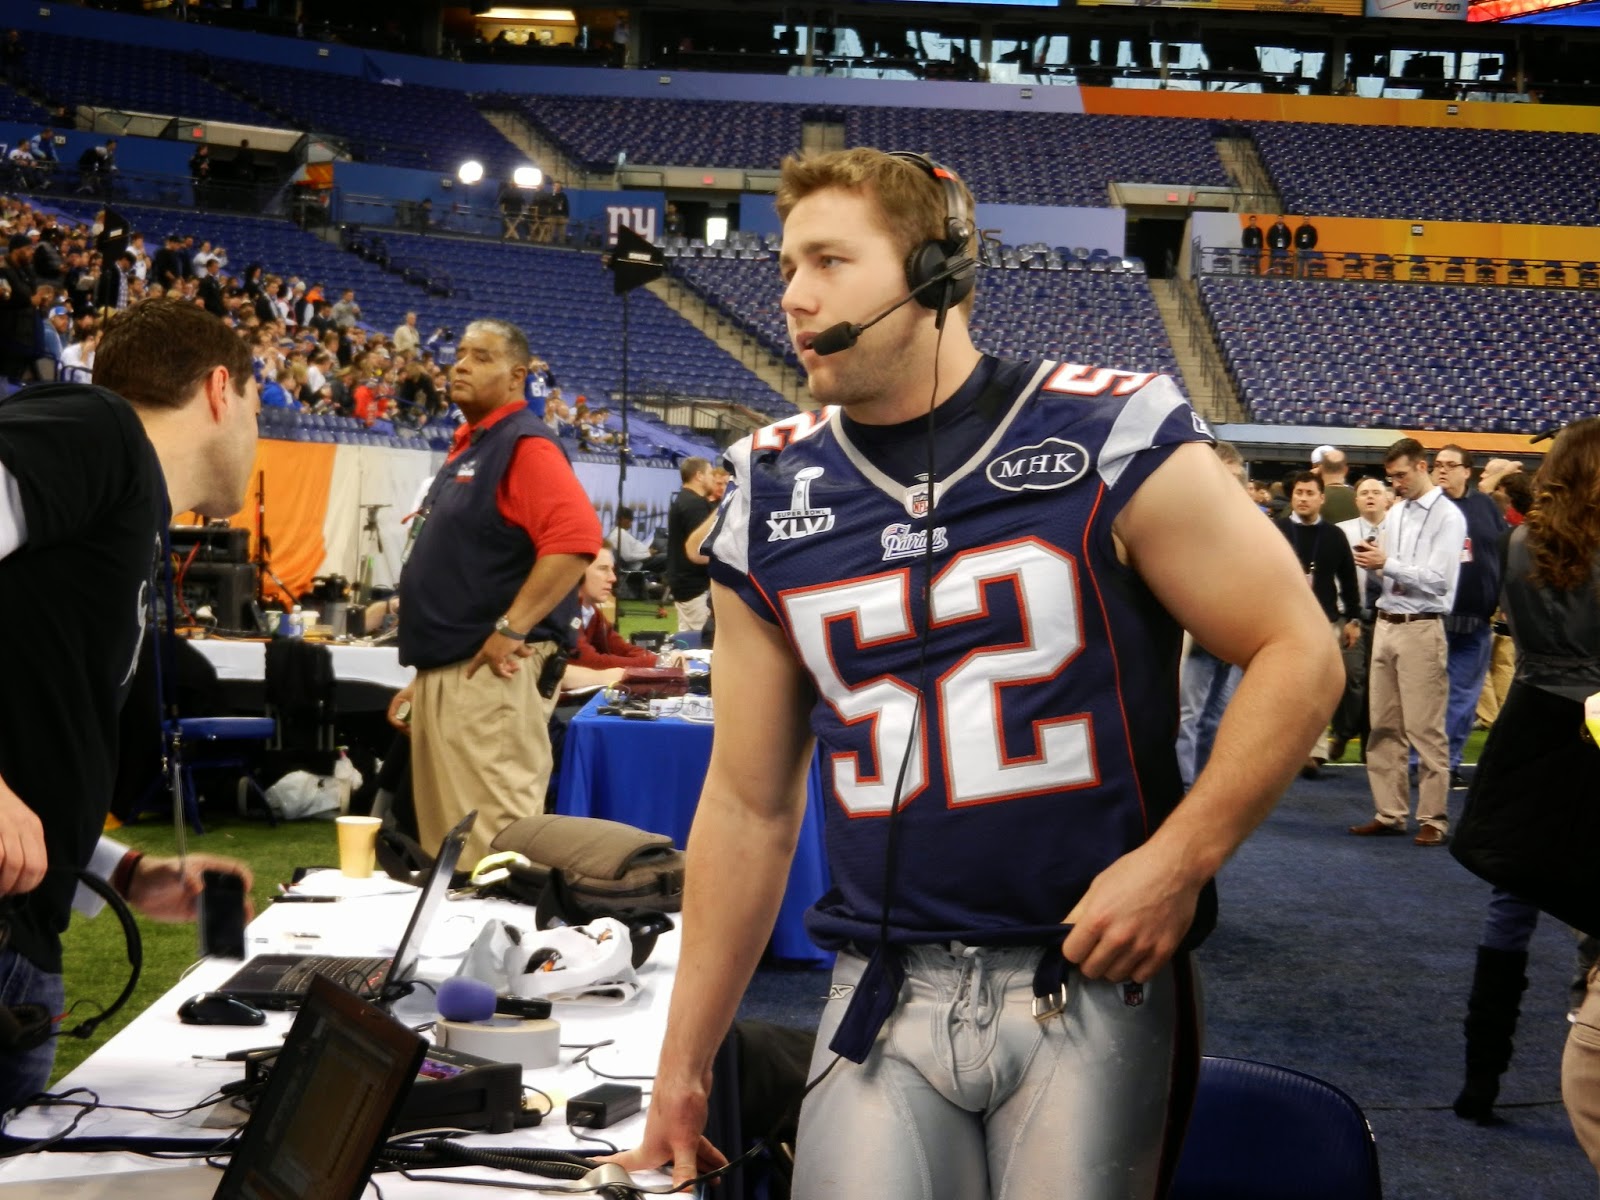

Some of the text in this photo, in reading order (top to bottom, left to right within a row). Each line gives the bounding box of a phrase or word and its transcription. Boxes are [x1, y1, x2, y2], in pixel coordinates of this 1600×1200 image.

[1413, 1, 1461, 12] verizon
[997, 453, 1076, 478] MHK
[778, 535, 1102, 818] 52
